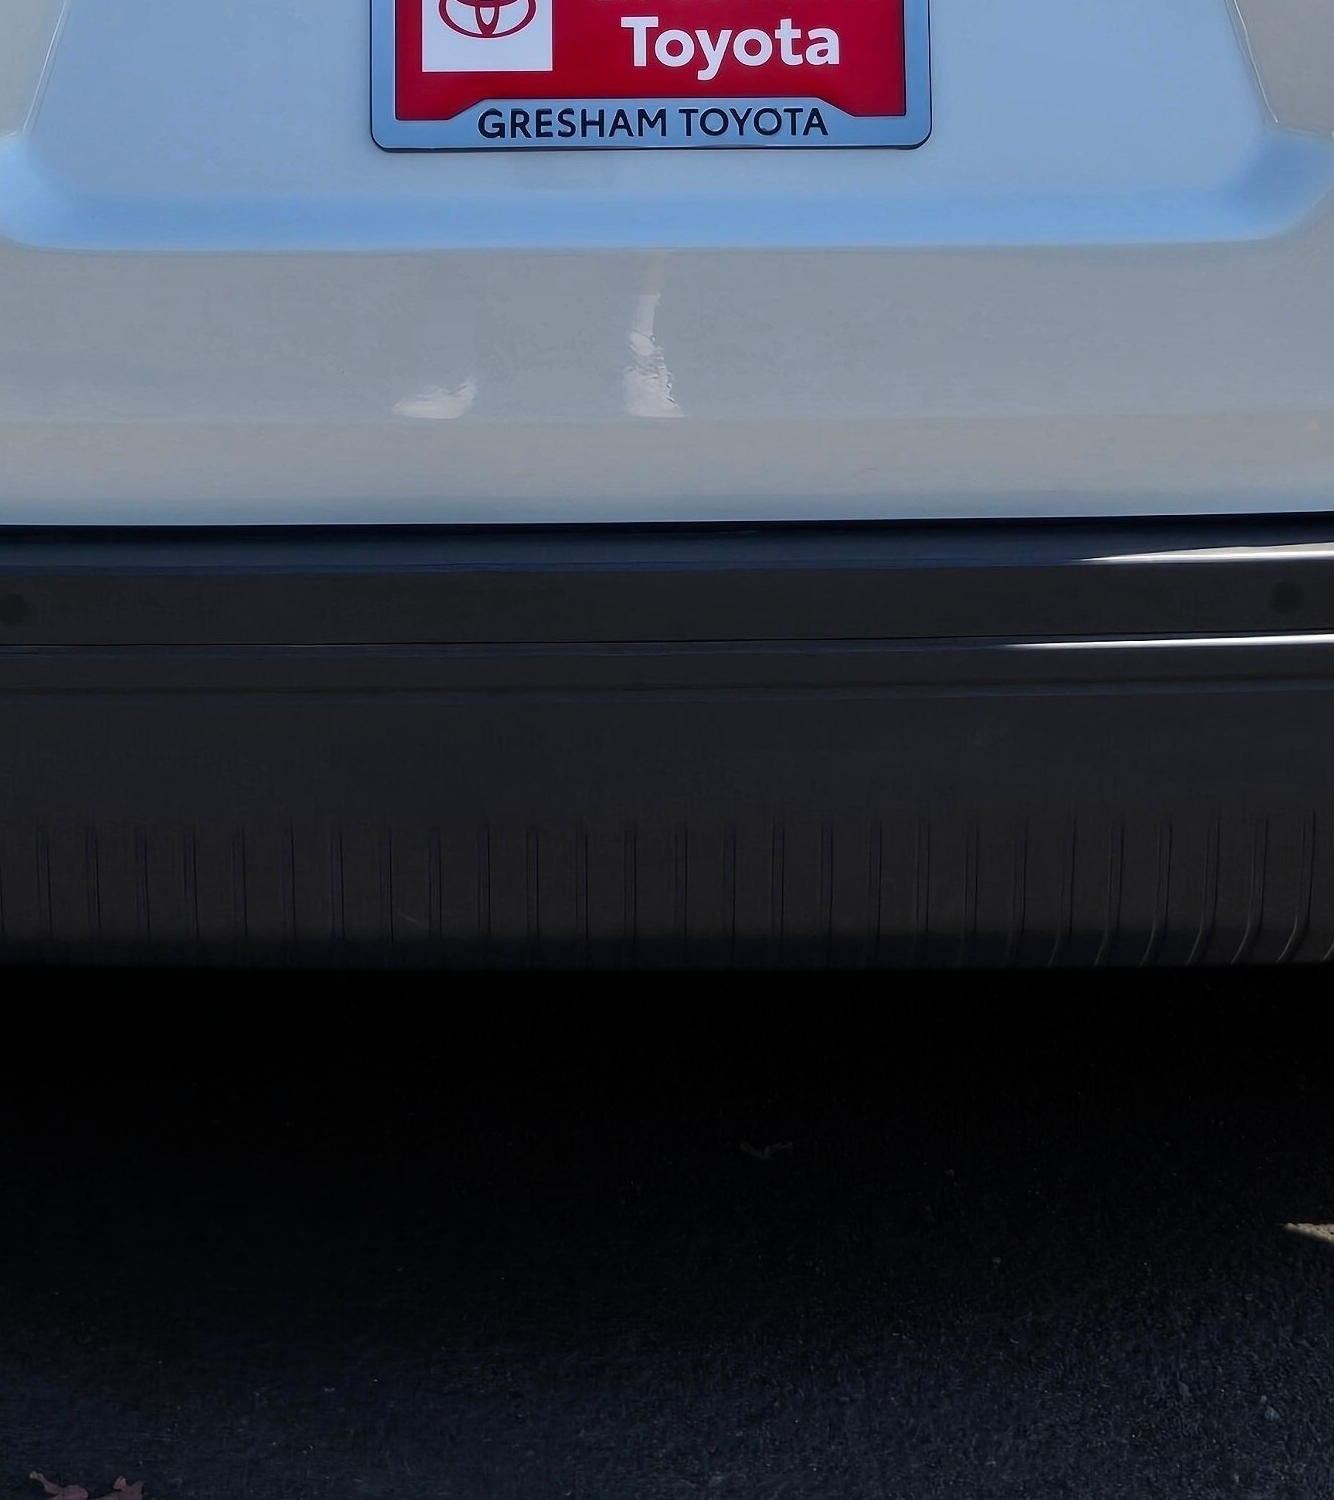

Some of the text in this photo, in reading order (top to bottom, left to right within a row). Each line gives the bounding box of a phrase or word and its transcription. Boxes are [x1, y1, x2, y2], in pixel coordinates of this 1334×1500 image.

[620, 15, 841, 81] Toyota
[477, 106, 829, 140] GRESHAM TOYOTA
